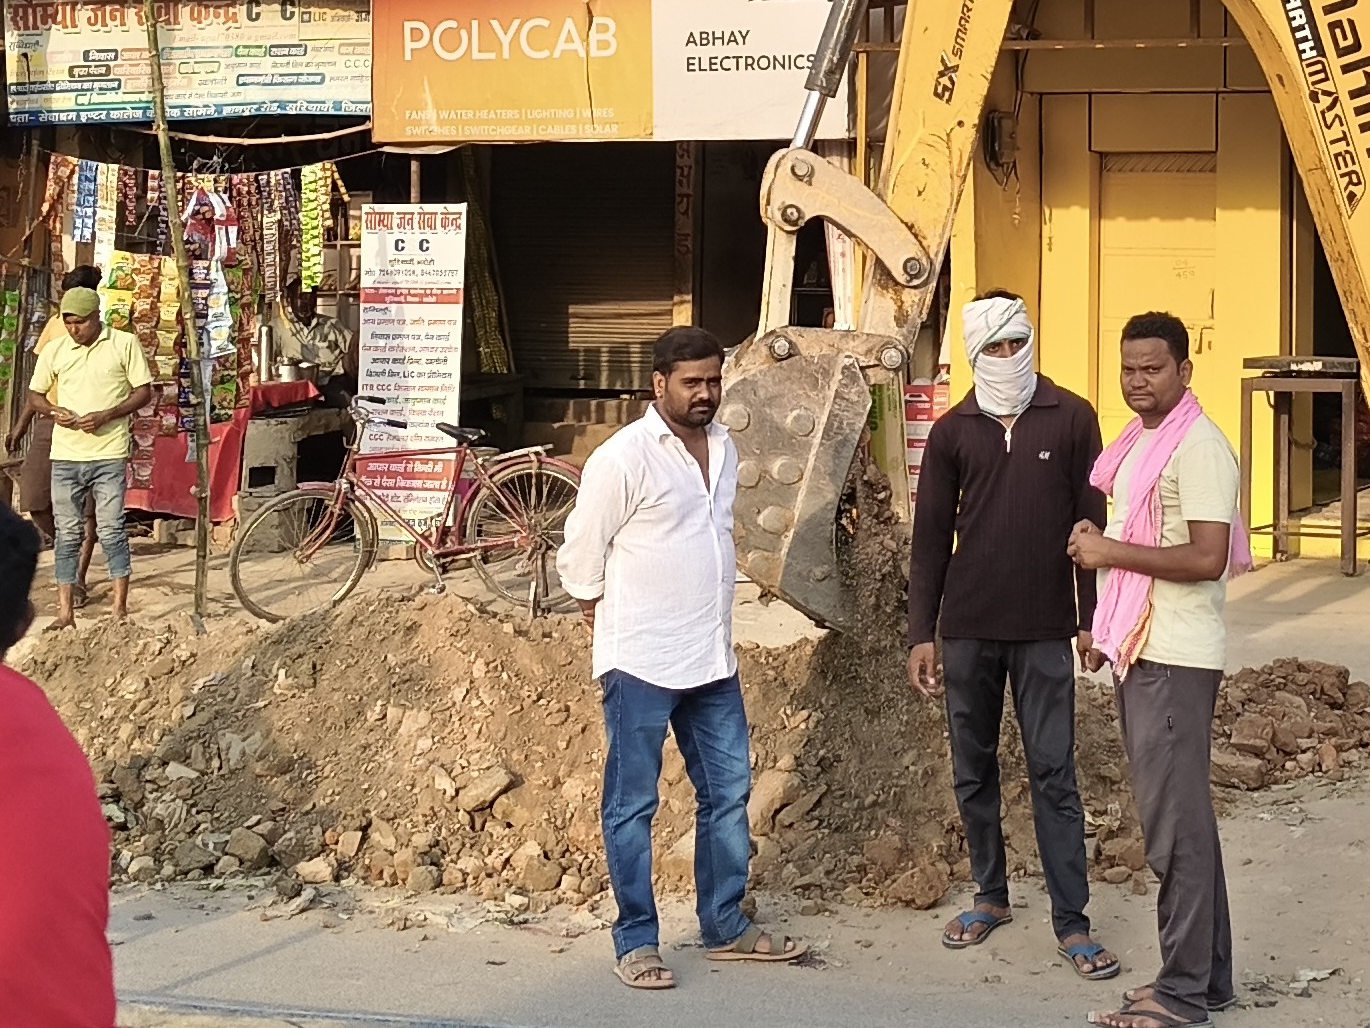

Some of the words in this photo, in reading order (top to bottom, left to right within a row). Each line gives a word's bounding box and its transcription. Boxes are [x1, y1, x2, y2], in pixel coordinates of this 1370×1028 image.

[82, 0, 130, 31] जन
[403, 16, 619, 62] POLYCAB
[685, 30, 751, 47] ABHAY
[405, 109, 431, 120] FANS
[438, 109, 474, 120] WATER
[475, 109, 520, 120] HEATERS
[527, 108, 575, 119] LIGHTING
[581, 107, 615, 119] WIRES
[463, 125, 532, 136] SWITCHGEAR
[538, 124, 577, 136] CABLES
[584, 123, 619, 136] SOLAR
[396, 211, 415, 231] जन
[417, 206, 439, 231] सेवा
[440, 206, 463, 232] केन्द्र
